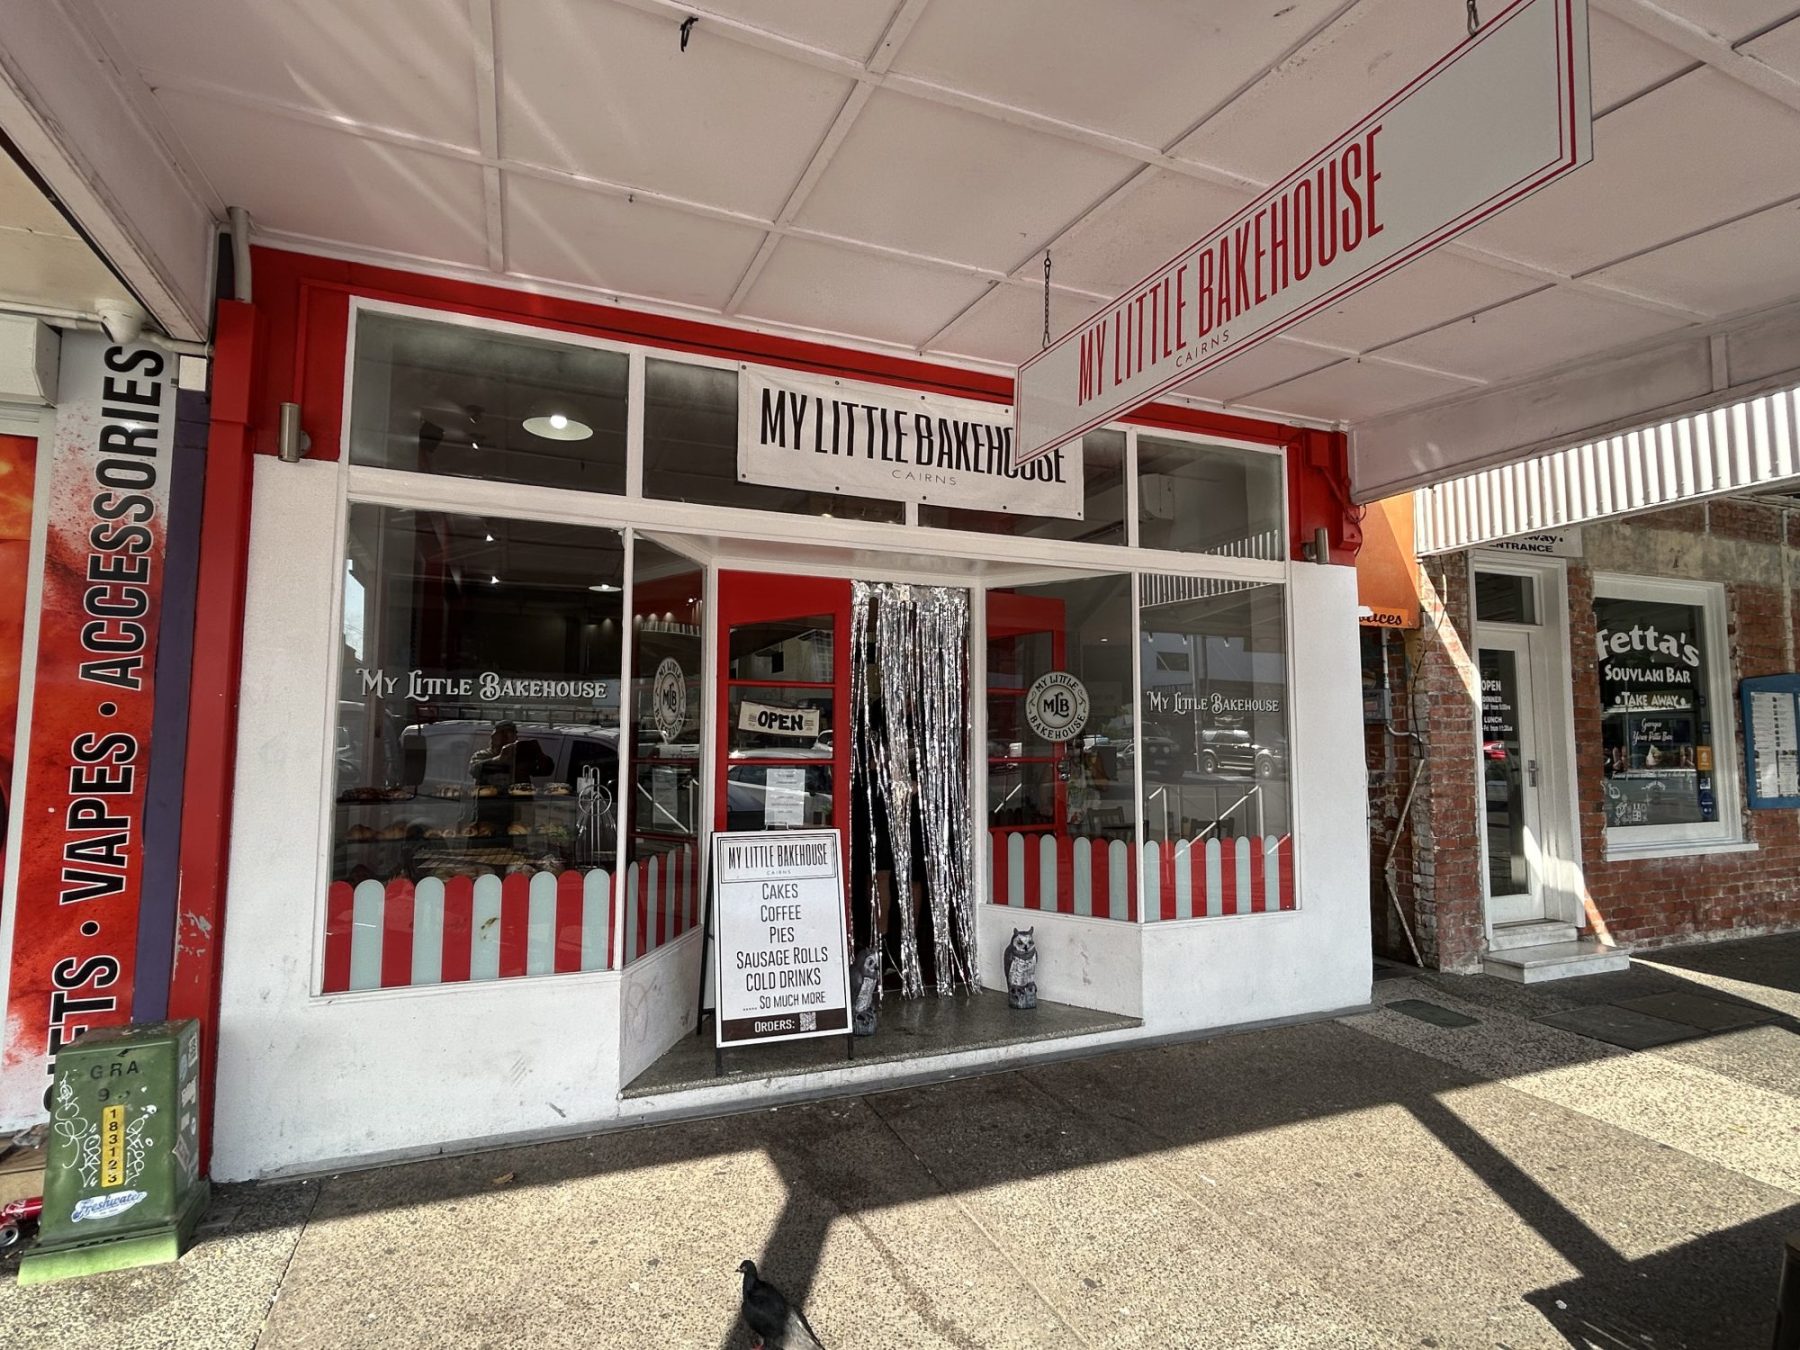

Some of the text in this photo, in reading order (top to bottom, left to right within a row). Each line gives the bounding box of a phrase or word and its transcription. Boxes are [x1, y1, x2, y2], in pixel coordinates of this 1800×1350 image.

[1078, 124, 1384, 407] MY LITTLE BAKEHOUSE
[1175, 329, 1230, 369] CAIRNS
[760, 387, 808, 451] MY
[813, 397, 909, 464] LITTLE
[891, 468, 957, 486] CAIRNS
[79, 345, 164, 692] ACCESSORIES
[1489, 541, 1554, 553] NTRANCE
[1596, 624, 1700, 667] Fetta's
[355, 668, 608, 701] MY LITTLE BAKEHOUSE
[1035, 674, 1079, 693] MY LITTLE
[1605, 664, 1691, 683] SOUVLAKI BAR
[1481, 680, 1502, 691] OPEN
[1043, 692, 1070, 718] MLB
[1146, 691, 1280, 715] MY LITTLE BAKEHOUSE
[1621, 691, 1679, 708] TAKE AWAY
[757, 710, 804, 732] OPEN
[1030, 714, 1086, 739] BAKEHOUSE
[1484, 716, 1503, 724] LUNCH
[60, 731, 138, 906] VAPES
[728, 843, 829, 869] MY LITTLE BAKEHOUSE
[762, 883, 799, 901] CAKES
[760, 904, 802, 922] COFFEE
[769, 926, 795, 944] PIES
[736, 946, 829, 969] SAUSAGE ROLLS
[746, 967, 821, 992] COLD DRINKS
[760, 995, 771, 1009] SO
[773, 993, 799, 1008] MUCH
[801, 991, 826, 1005] MORE
[754, 1020, 796, 1034] ORDERS:
[72, 1192, 146, 1220] Freshwater
